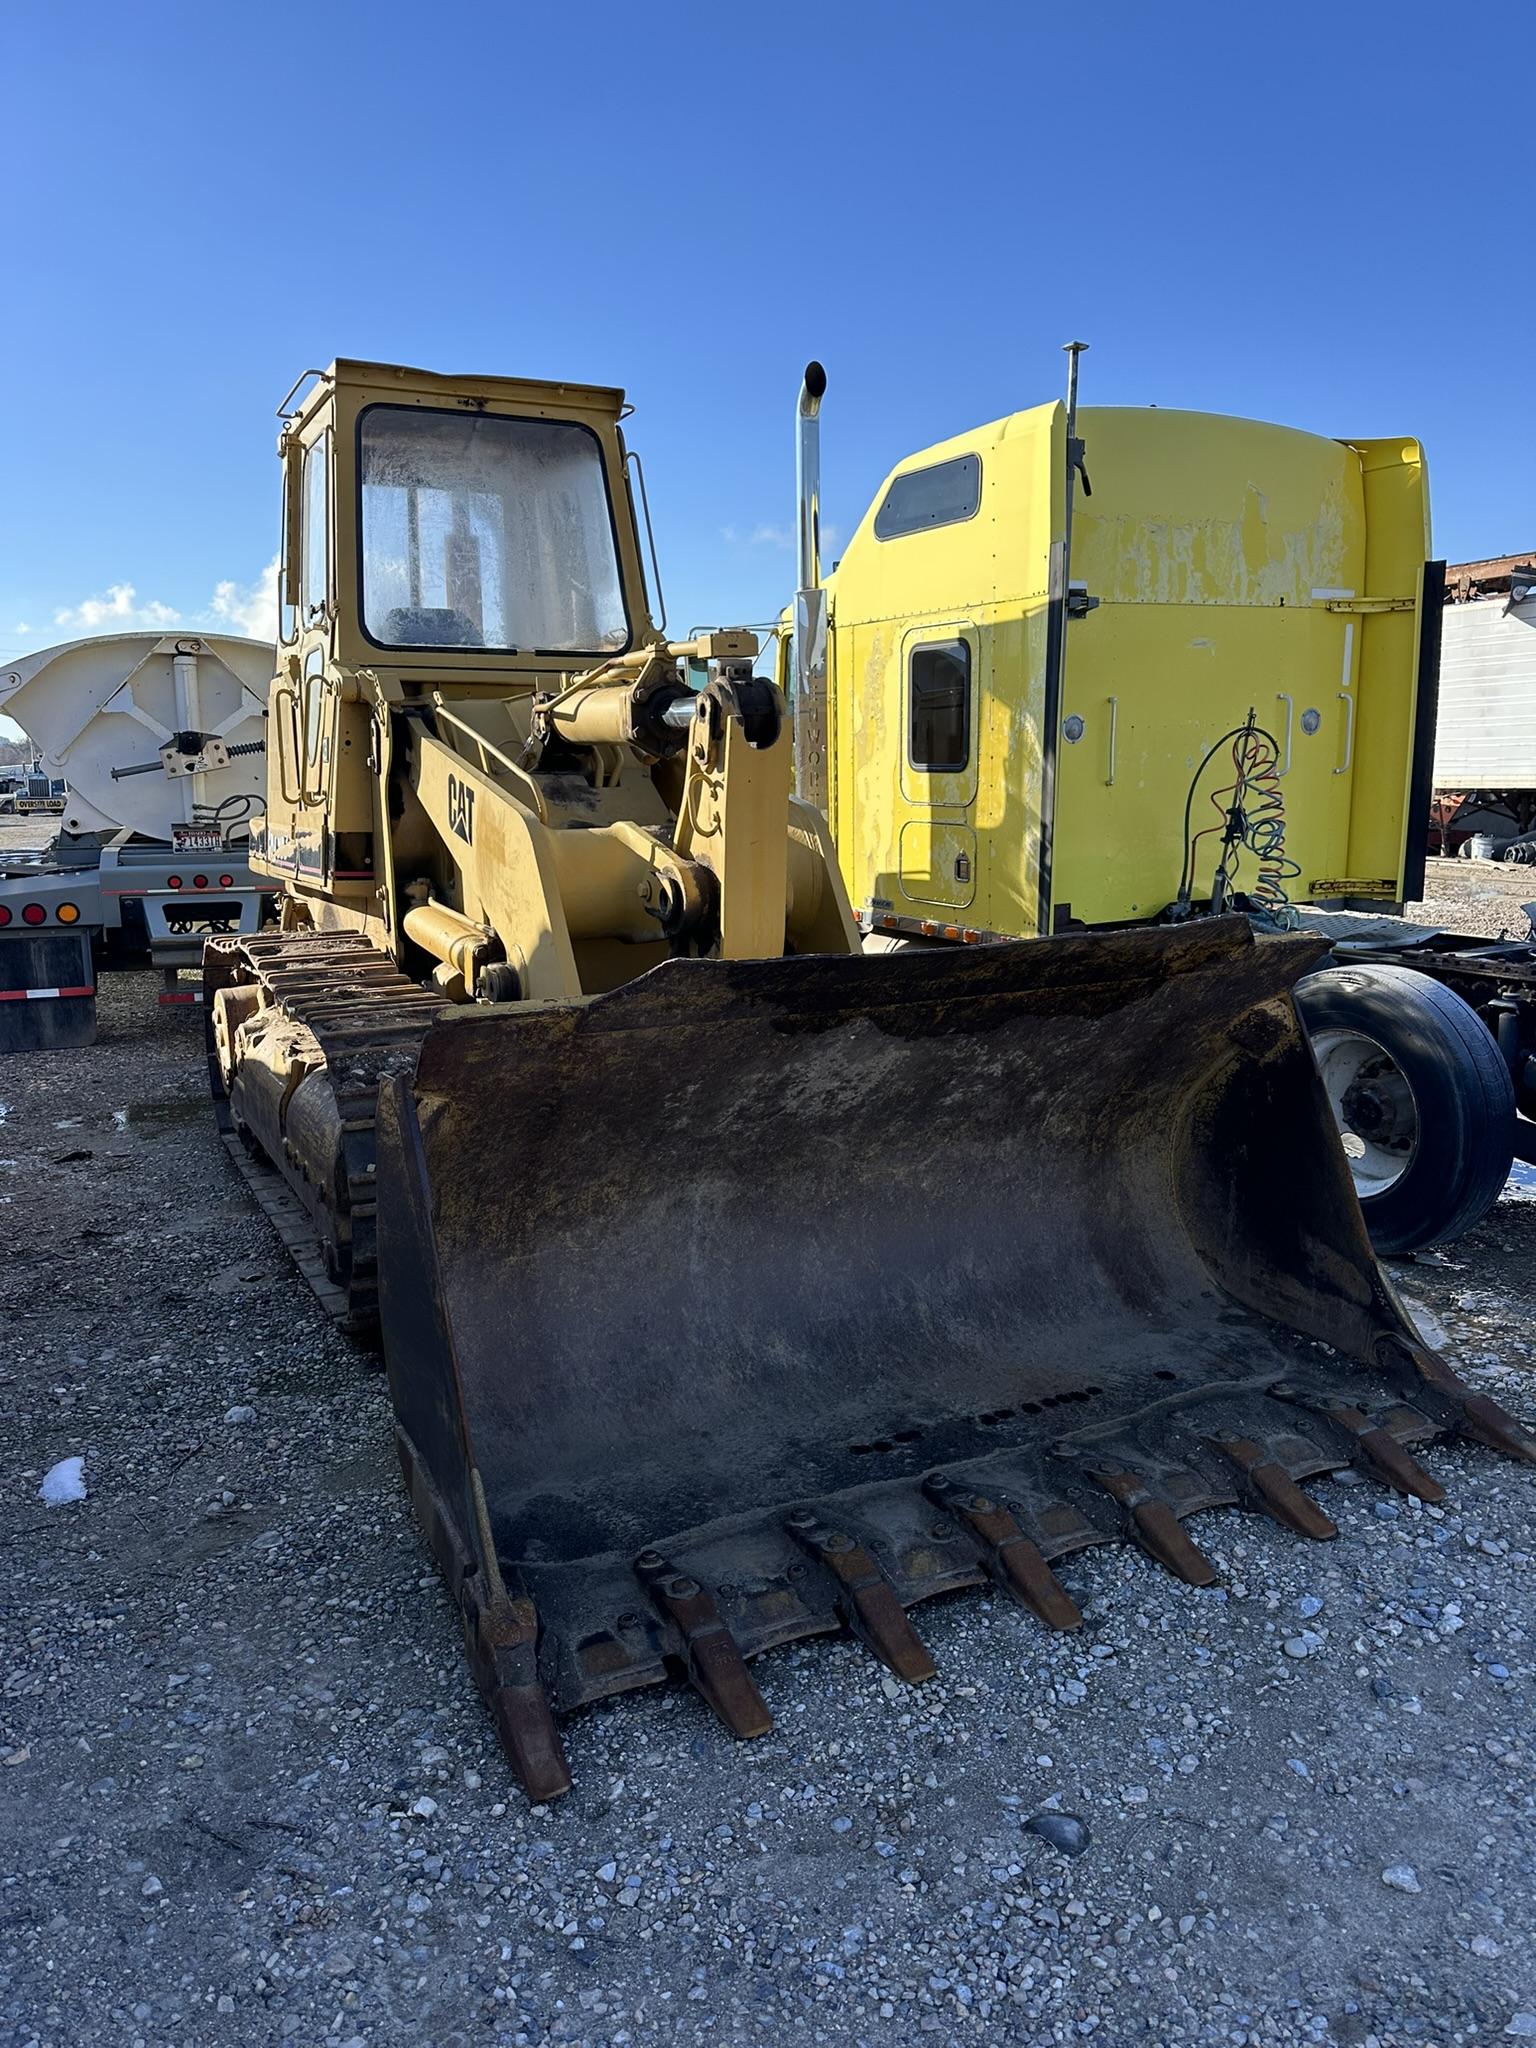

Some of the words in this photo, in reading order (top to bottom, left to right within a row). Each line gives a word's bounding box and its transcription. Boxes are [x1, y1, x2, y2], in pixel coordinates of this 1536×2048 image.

[808, 663, 821, 807] KENWORT
[19, 800, 45, 808] OVERSIZE
[46, 800, 62, 808] LOAD
[448, 773, 474, 847] CAT
